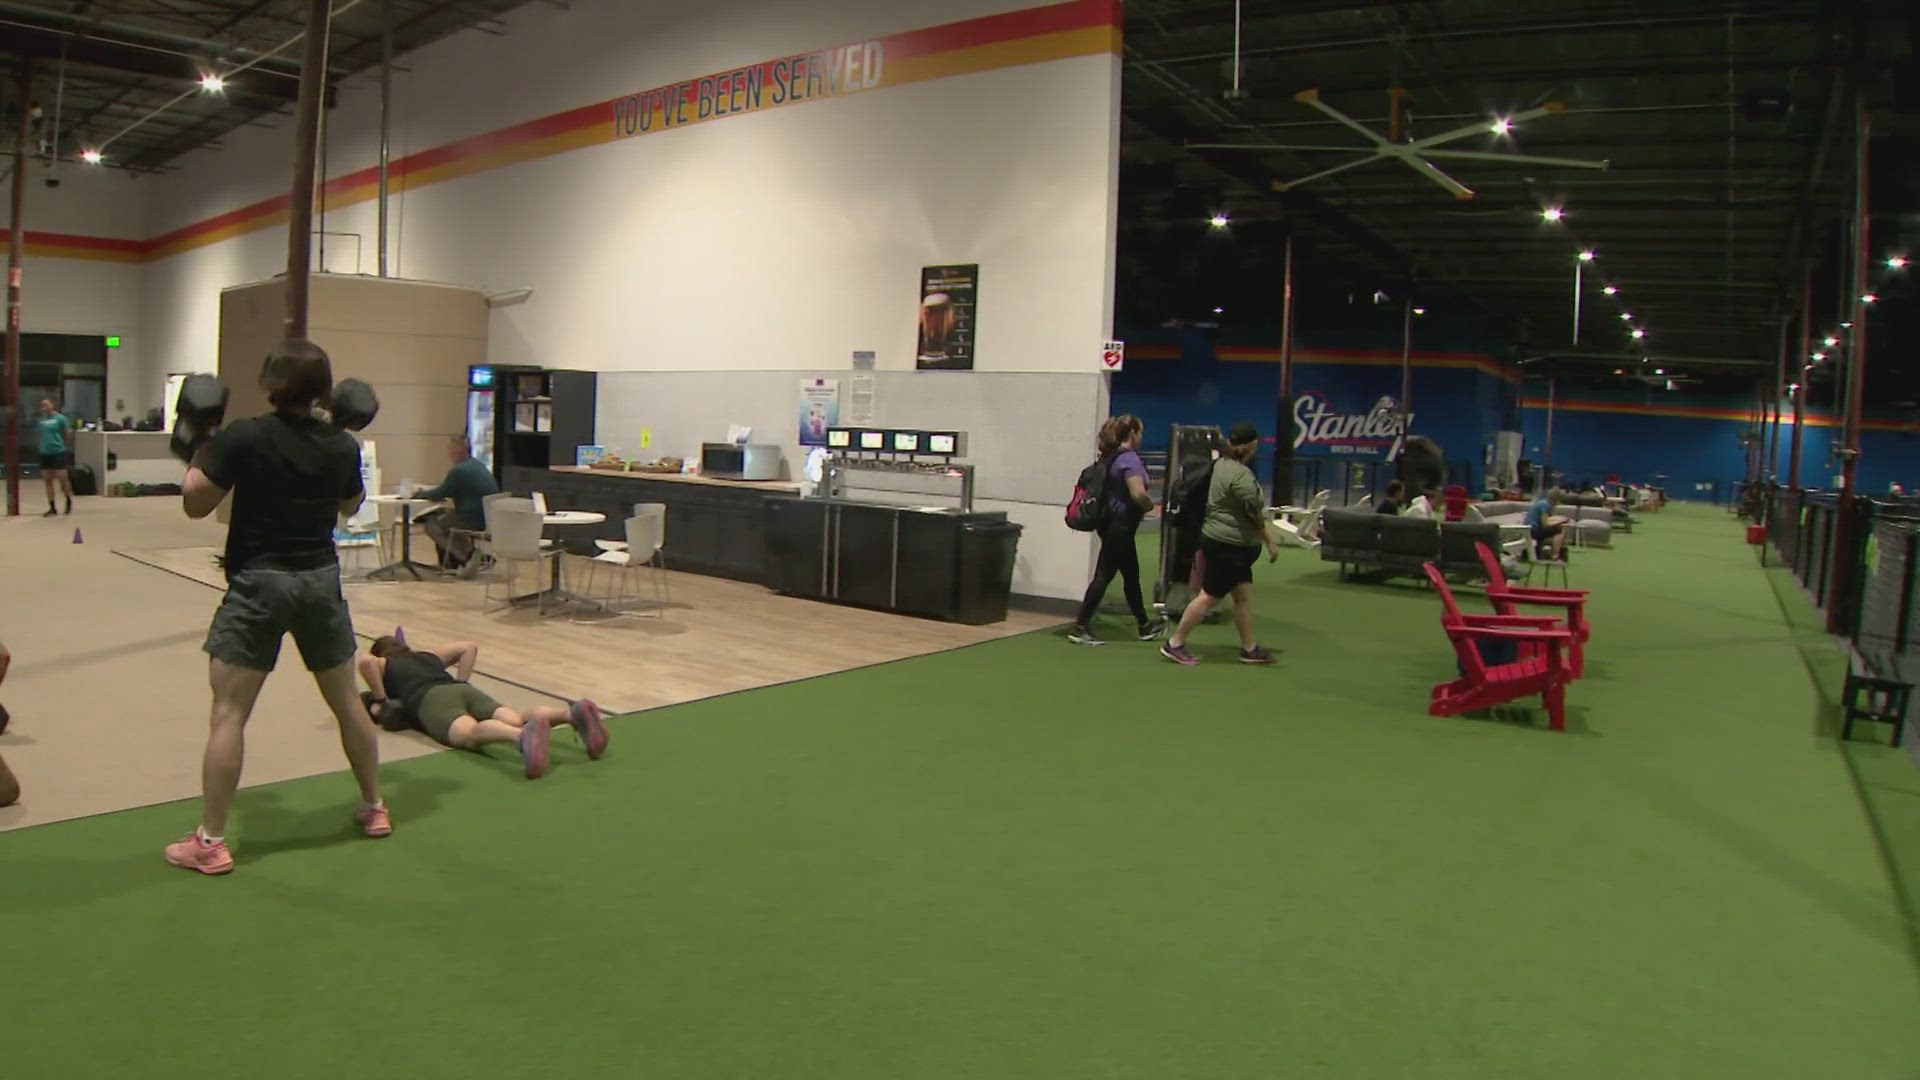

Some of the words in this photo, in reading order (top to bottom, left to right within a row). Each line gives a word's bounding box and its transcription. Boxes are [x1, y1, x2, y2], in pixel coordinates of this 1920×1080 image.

[613, 83, 690, 136] YOU'VE
[698, 65, 763, 118] BEEN
[772, 40, 884, 104] SERVED
